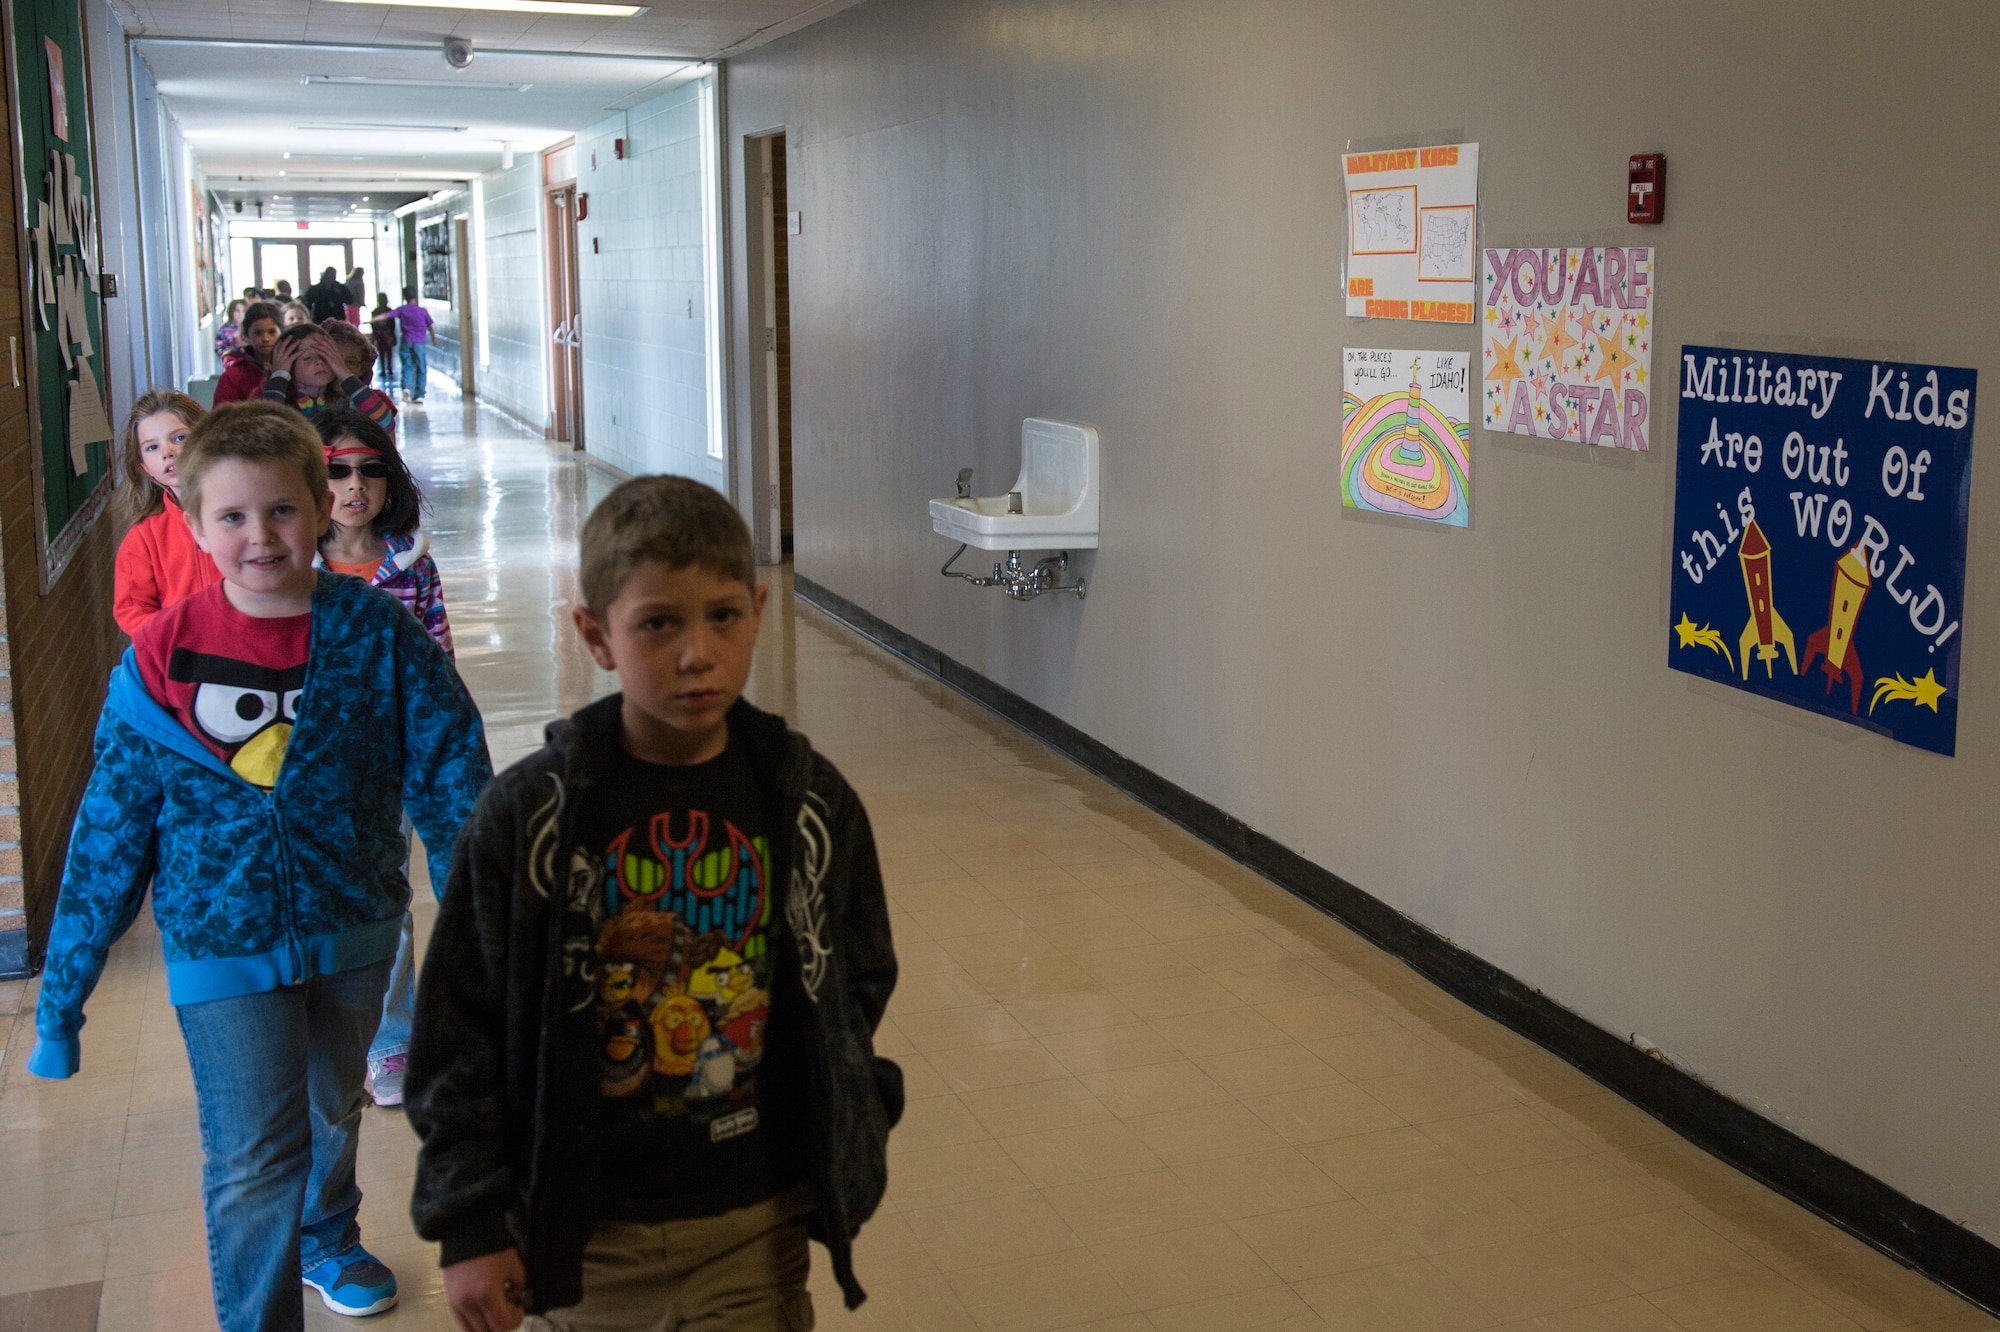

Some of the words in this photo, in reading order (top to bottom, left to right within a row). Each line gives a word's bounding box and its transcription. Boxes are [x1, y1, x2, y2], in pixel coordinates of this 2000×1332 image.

[1346, 150, 1418, 174] MILITARY
[1420, 146, 1459, 168] KIDS
[1646, 160, 1654, 169] FIRE
[1348, 277, 1373, 297] ARE
[1486, 248, 1567, 307] YOU
[1570, 247, 1649, 309] ARE
[1365, 299, 1409, 319] GOING
[1411, 300, 1474, 323] PLACES!
[1358, 351, 1367, 361] THE
[1370, 351, 1392, 363] PLACES
[1437, 356, 1454, 370] LIKE
[1429, 367, 1465, 393] IDAHO!
[1681, 353, 1842, 420] Military
[1865, 364, 1970, 430] Kids
[1507, 380, 1537, 436] A
[1547, 382, 1649, 452] STAR
[1700, 416, 1763, 473] Are
[1782, 430, 1850, 487] Out
[1882, 445, 1932, 501] Of
[1681, 486, 1755, 585] this
[1790, 491, 1959, 654] WORLD!
